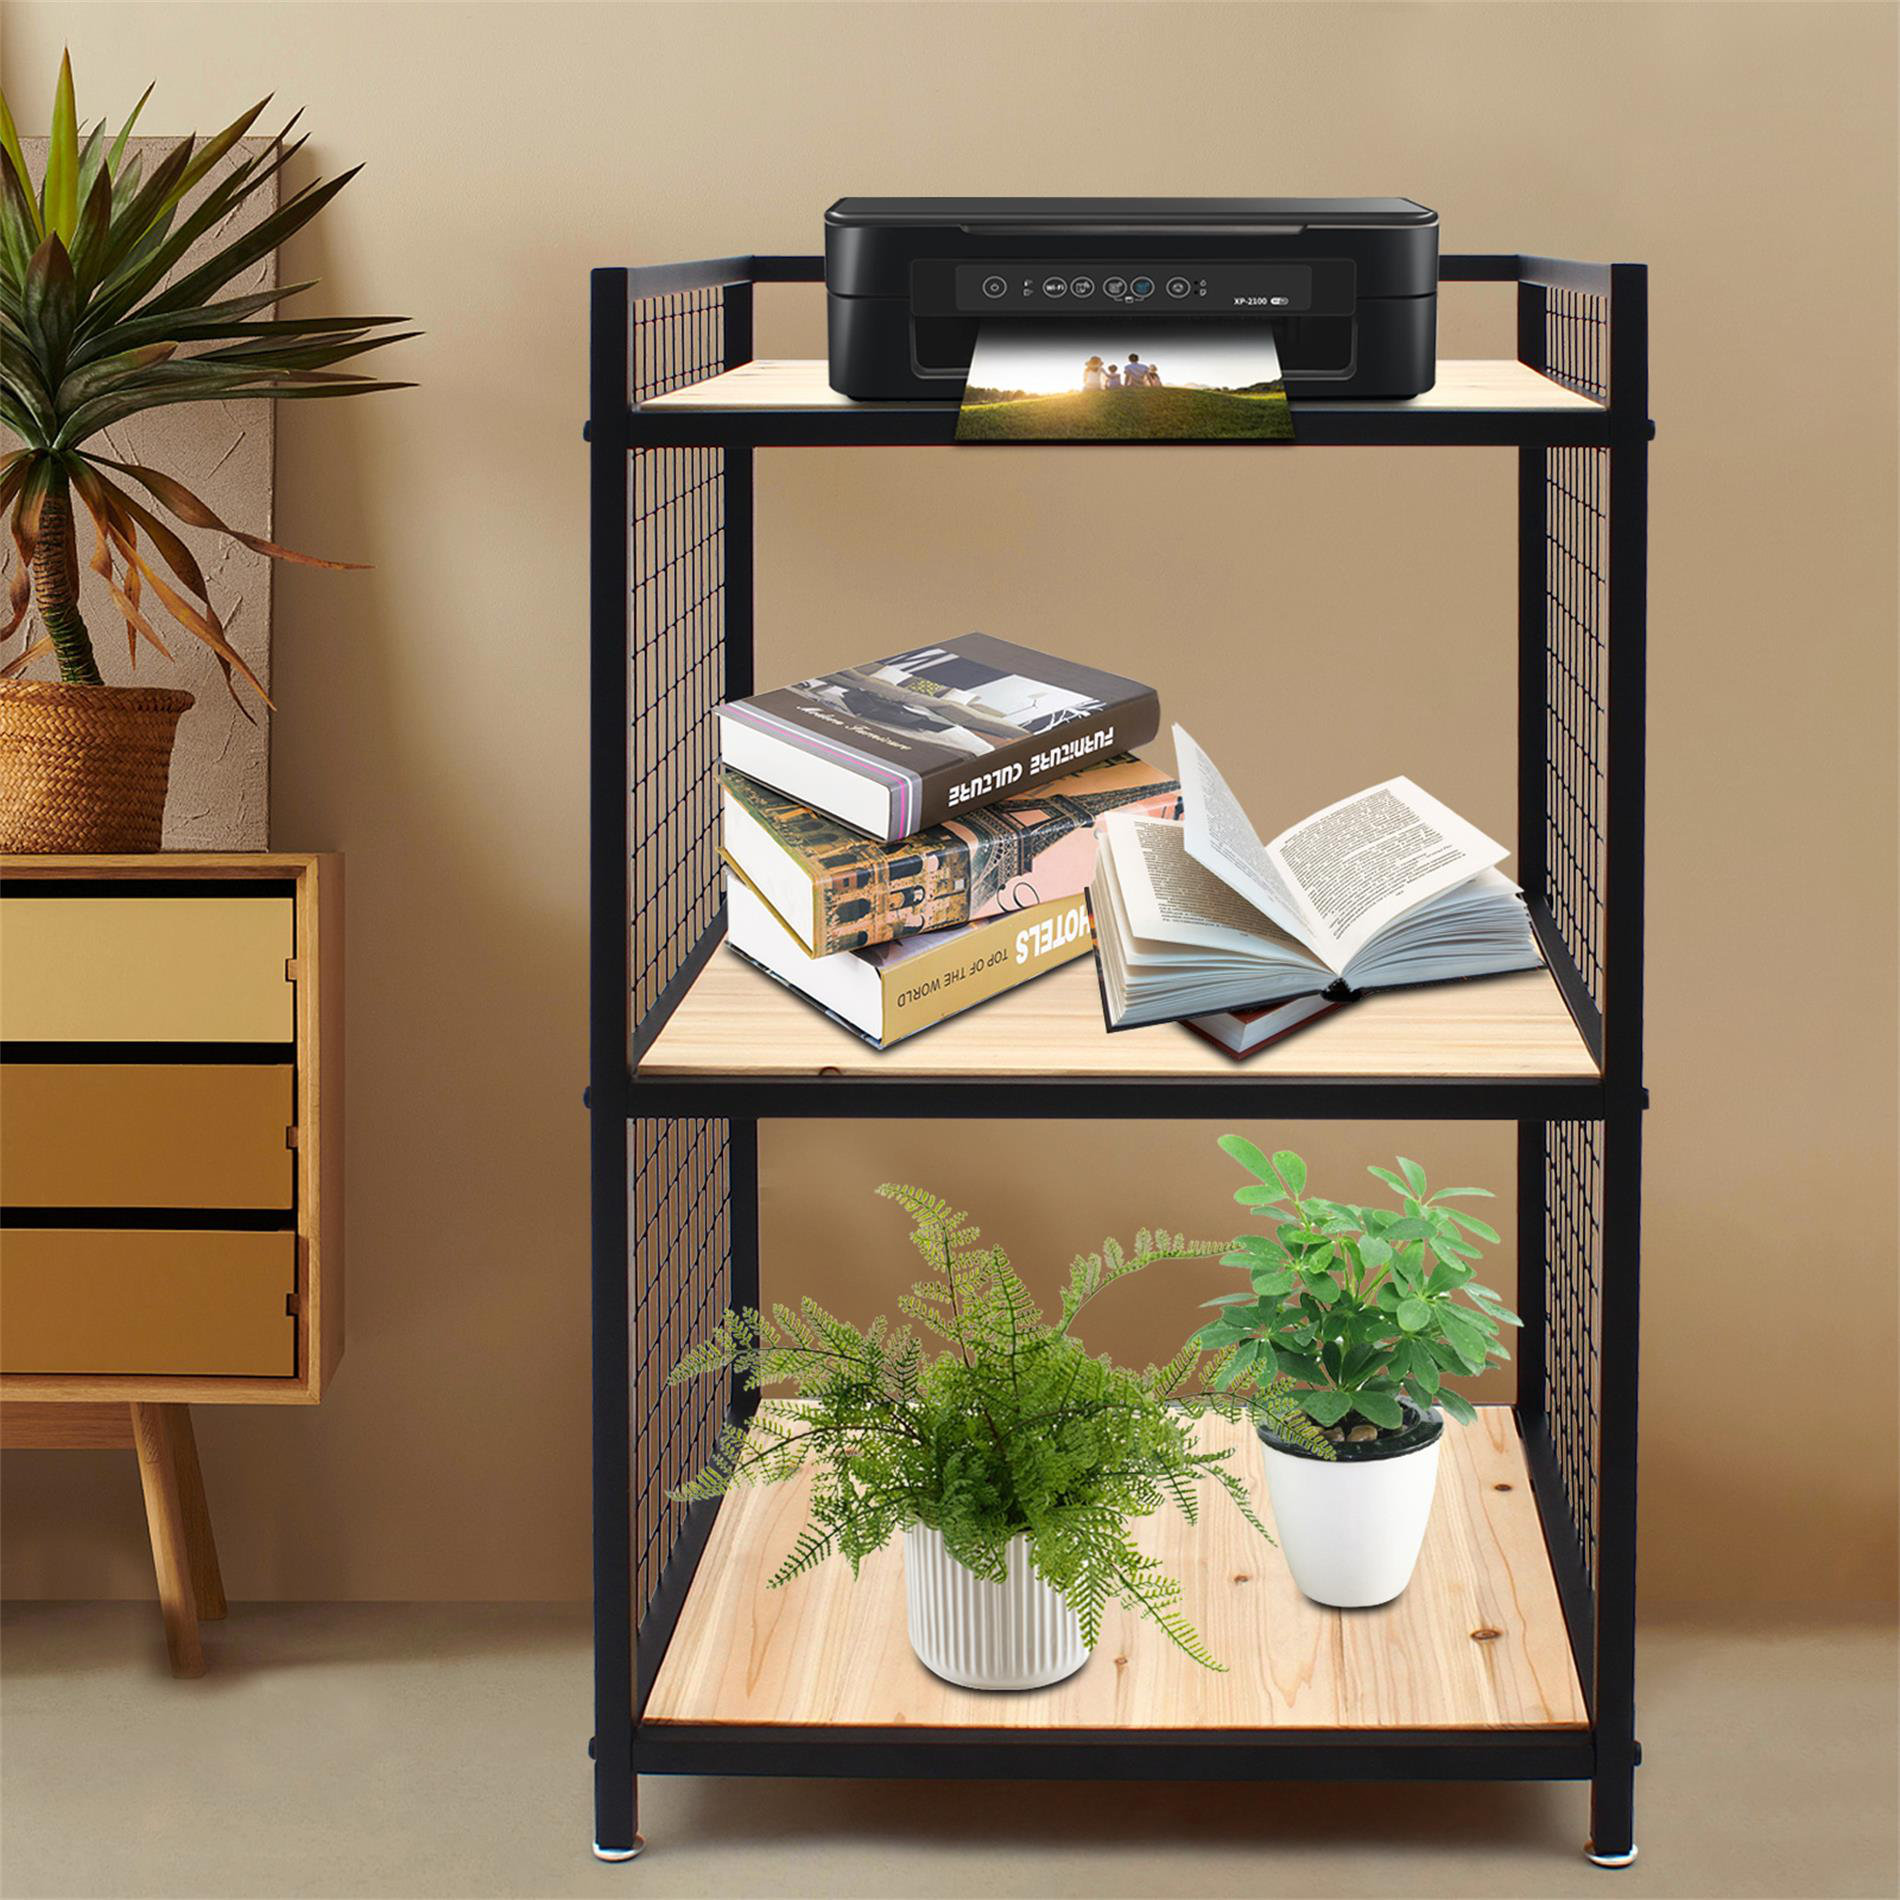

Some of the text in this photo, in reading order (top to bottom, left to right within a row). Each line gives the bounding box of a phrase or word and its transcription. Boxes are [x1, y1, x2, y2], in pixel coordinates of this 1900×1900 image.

[1233, 297, 1268, 306] XP-2100
[948, 761, 1023, 807] CULTURE
[1015, 904, 1091, 966] HOTELS
[897, 948, 1009, 1008] TOP OF THE WORLD
